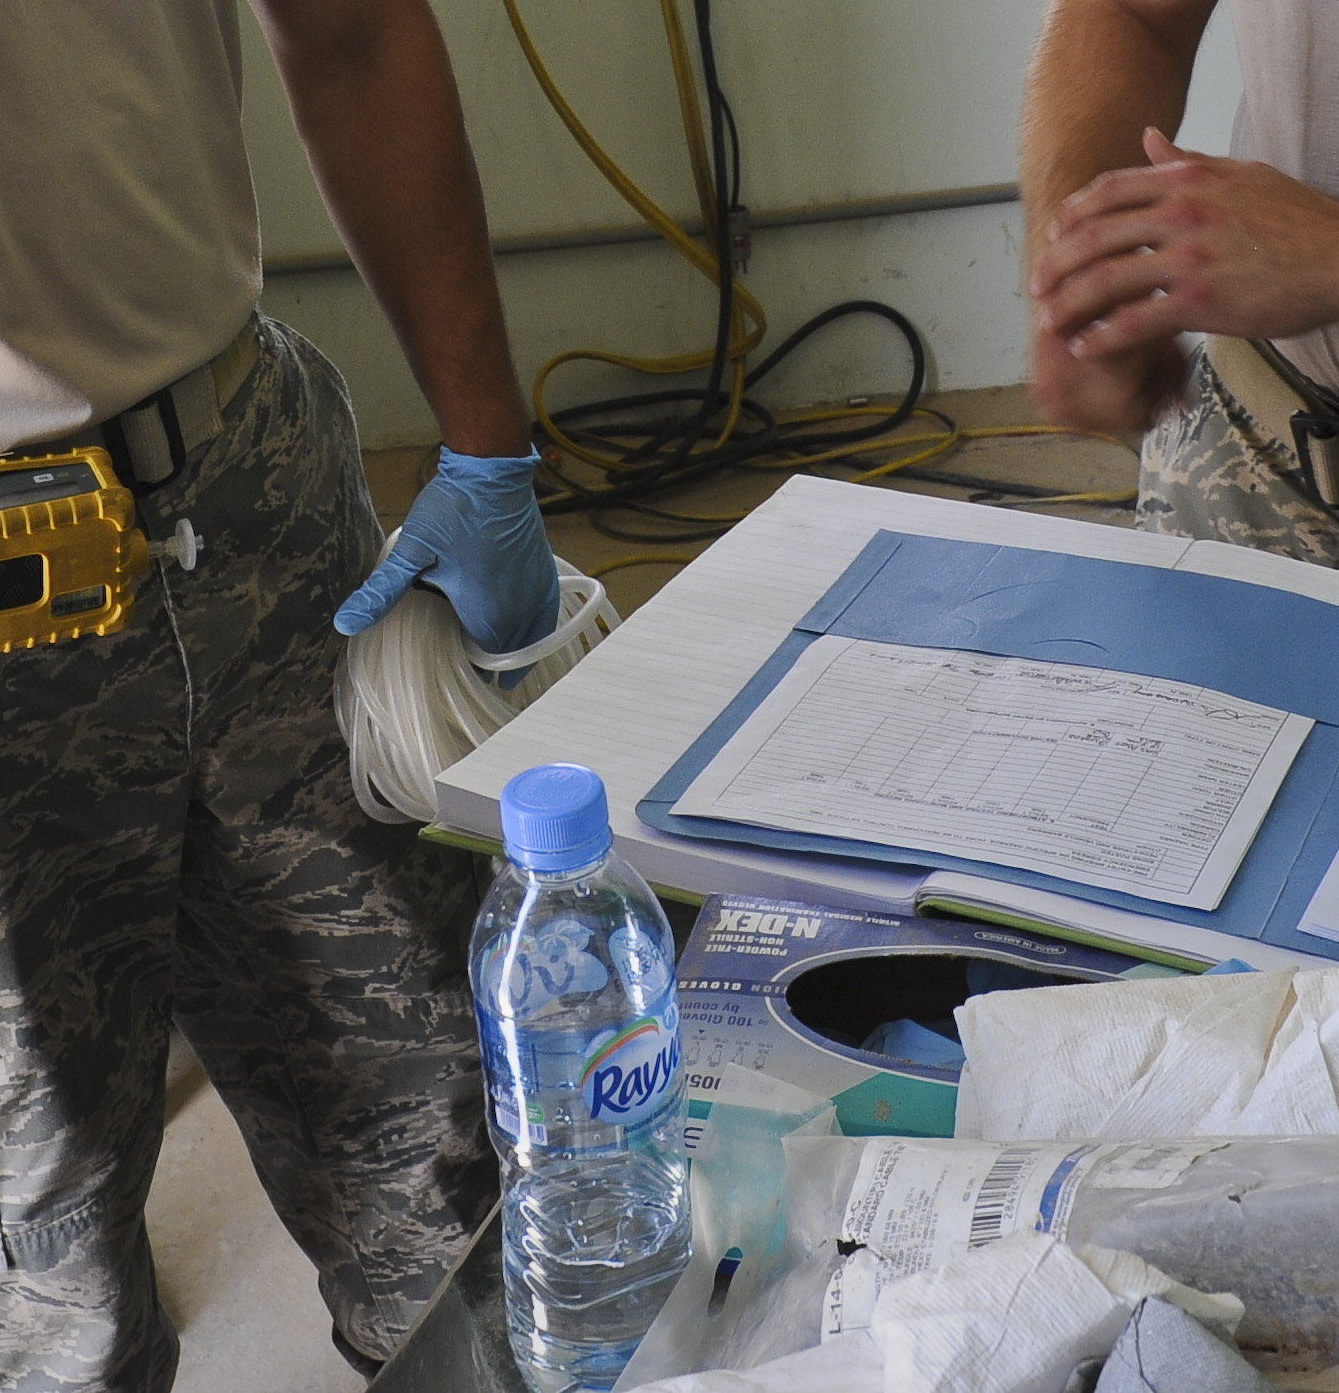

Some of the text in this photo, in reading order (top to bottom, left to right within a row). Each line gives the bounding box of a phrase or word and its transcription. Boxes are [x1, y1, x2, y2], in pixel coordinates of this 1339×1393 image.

[716, 909, 822, 939] N-DEX
[709, 933, 785, 946] NON-STERILE
[704, 944, 789, 957] POWDER-FREE
[677, 979, 743, 992] GLOVES
[726, 1016, 754, 1028] 100
[862, 1188, 886, 1243] TANDARD
